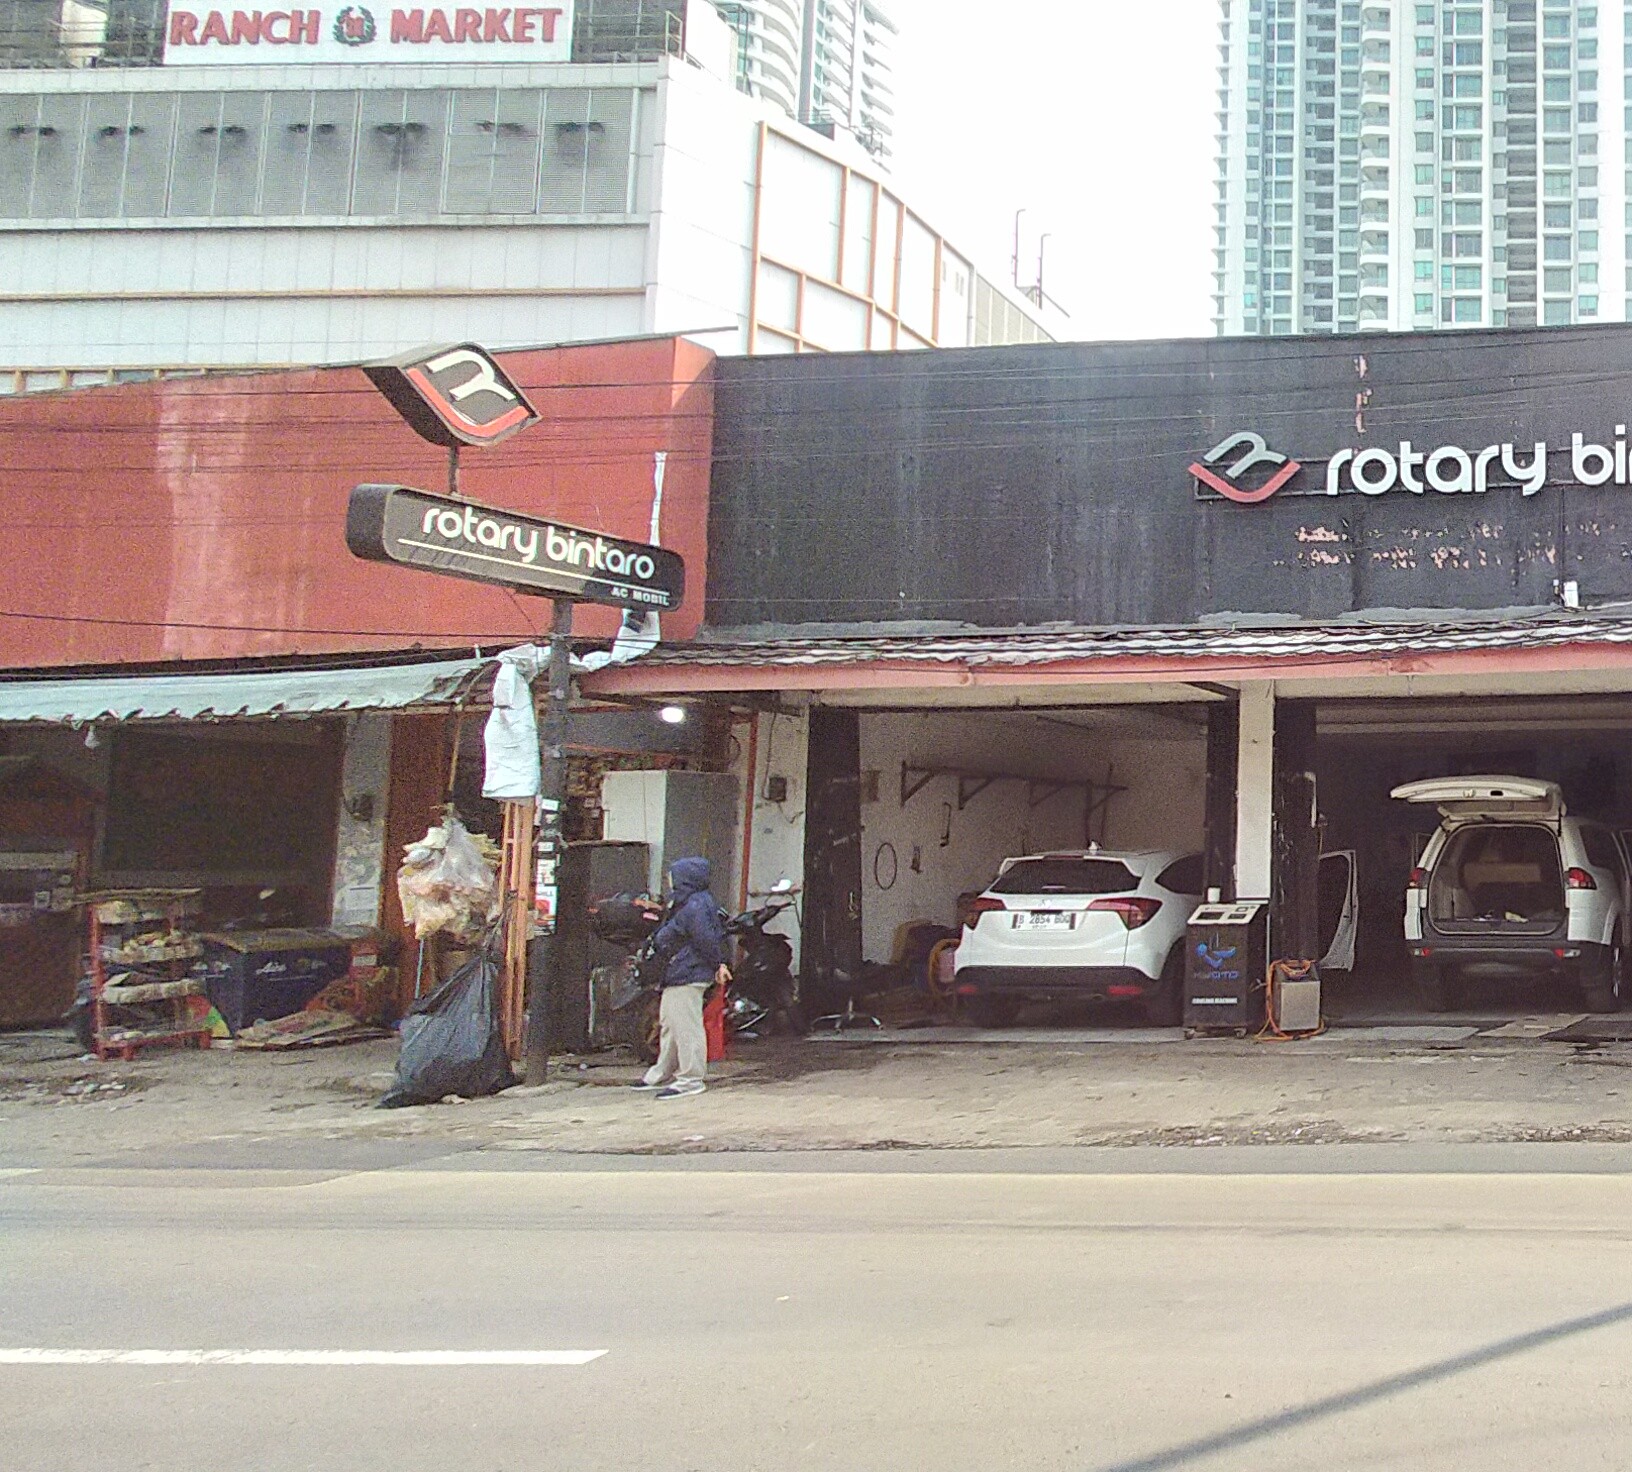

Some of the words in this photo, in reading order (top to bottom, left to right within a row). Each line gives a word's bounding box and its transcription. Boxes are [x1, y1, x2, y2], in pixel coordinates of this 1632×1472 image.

[170, 9, 321, 45] RANCH
[390, 8, 562, 44] MARKET
[1326, 440, 1547, 496] rotary
[421, 506, 539, 563] rotary
[546, 525, 655, 579] bintaro
[611, 586, 628, 598] AC
[633, 590, 670, 607] MOBIL
